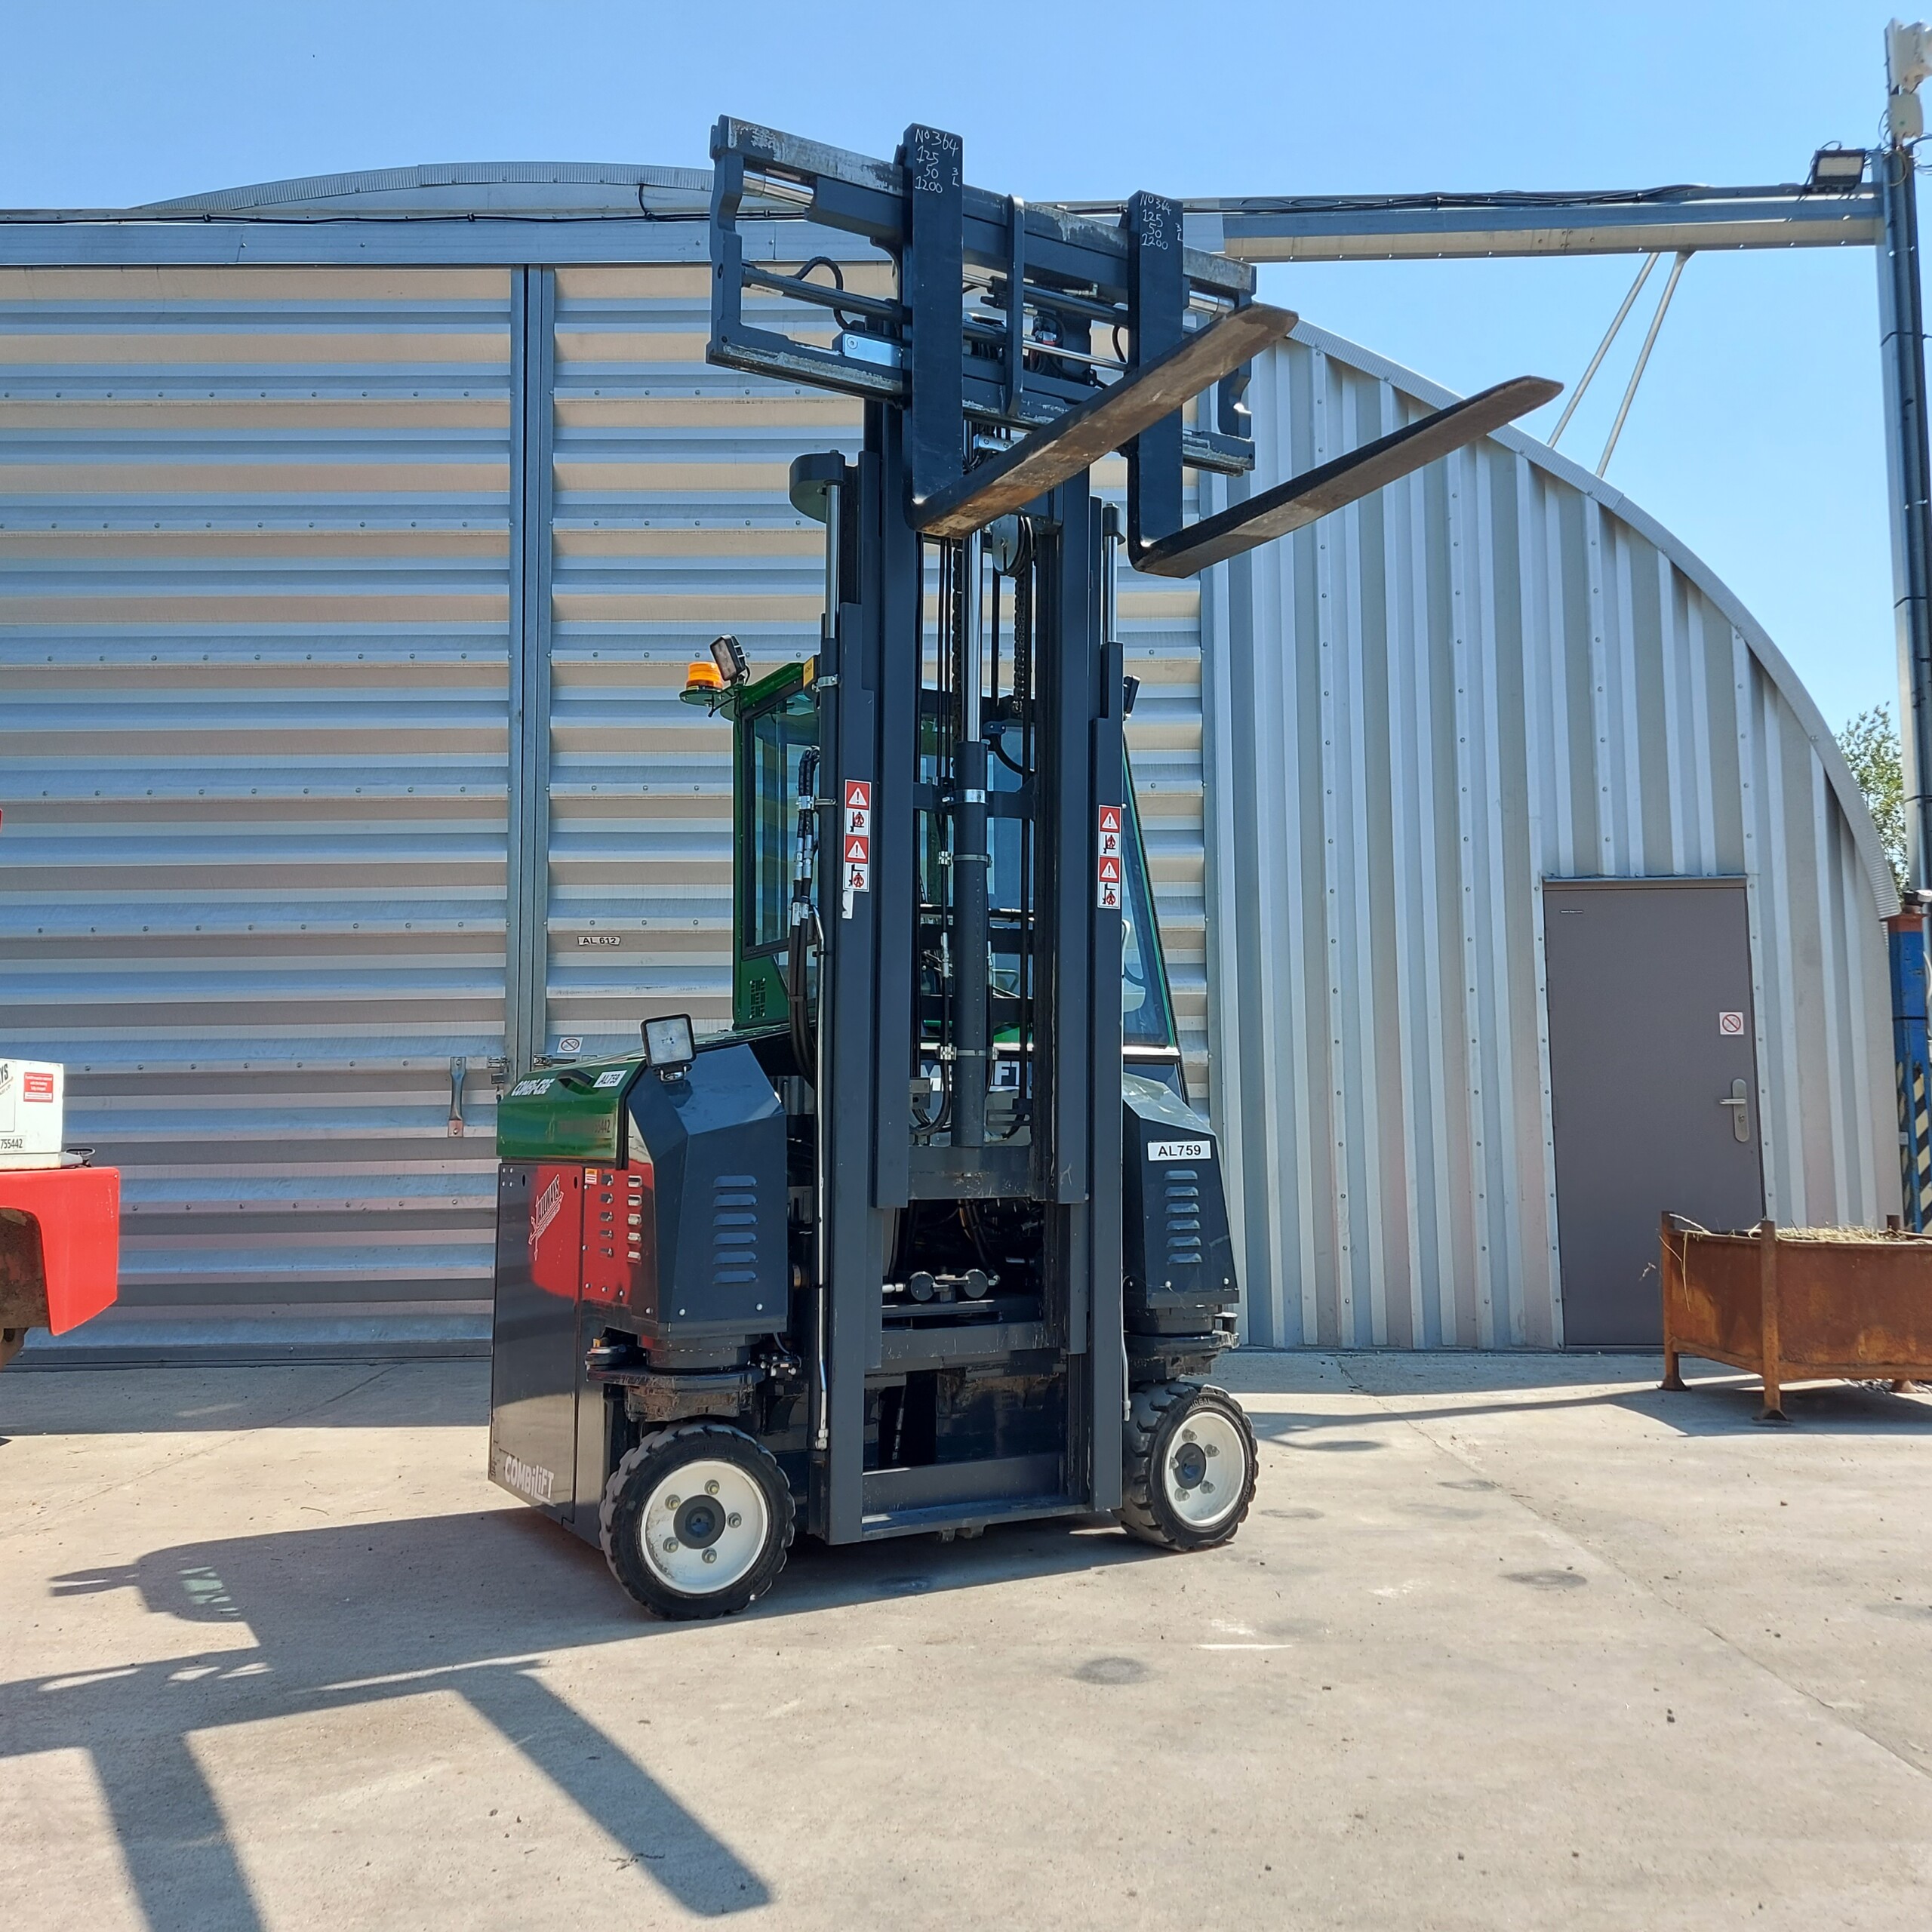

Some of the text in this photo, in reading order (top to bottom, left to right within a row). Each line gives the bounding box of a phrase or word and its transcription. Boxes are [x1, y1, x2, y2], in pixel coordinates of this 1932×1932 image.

[931, 131, 959, 157] 364
[916, 146, 939, 165] 125
[924, 165, 939, 179] 50
[915, 176, 943, 193] 1200
[1156, 198, 1171, 215] 364
[1143, 209, 1163, 227] 125
[1147, 223, 1162, 238] 50
[1158, 1145, 1201, 1157] AL759
